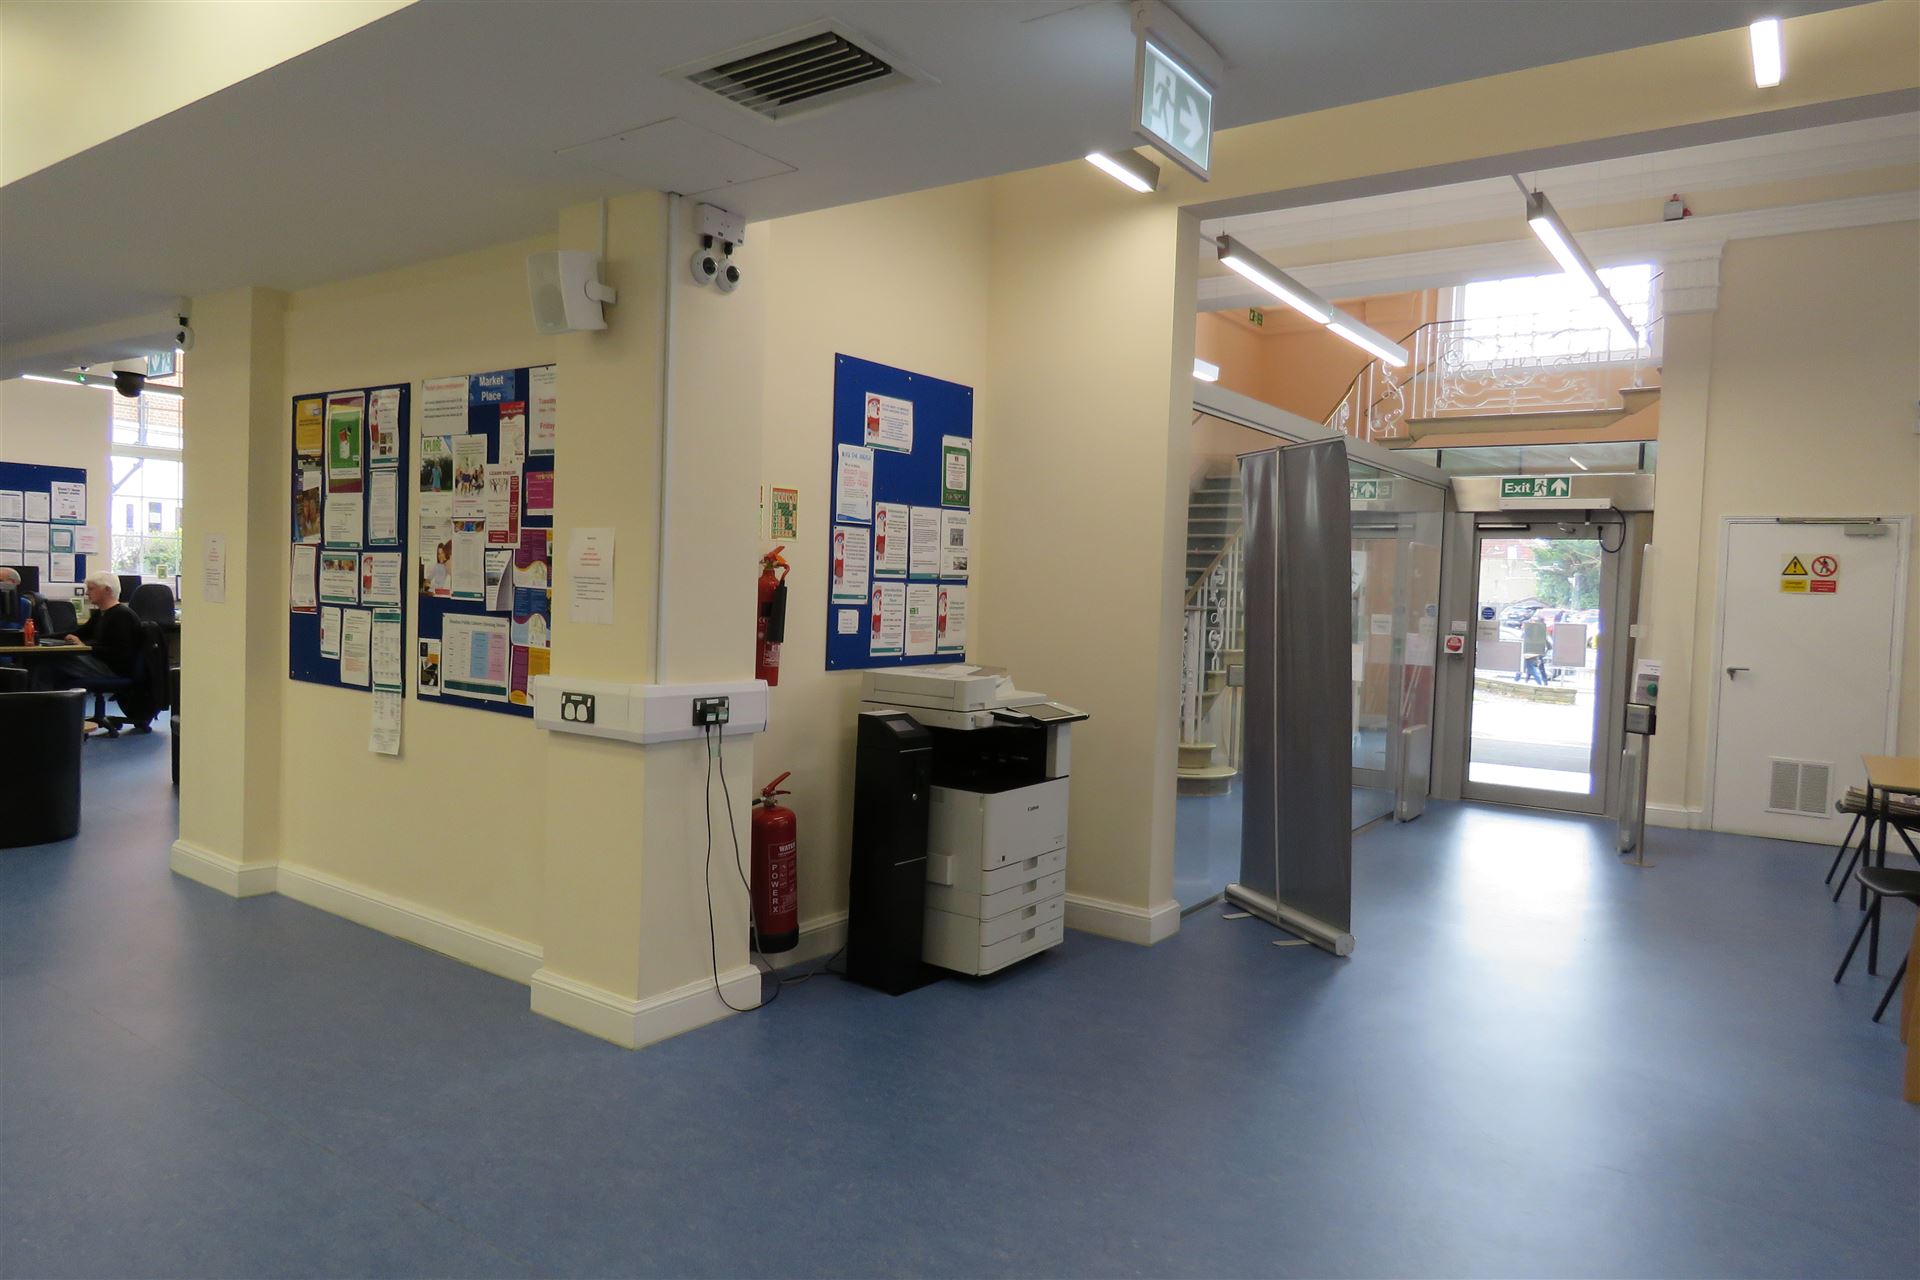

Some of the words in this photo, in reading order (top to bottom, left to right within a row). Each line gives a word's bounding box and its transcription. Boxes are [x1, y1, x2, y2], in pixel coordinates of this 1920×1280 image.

[479, 375, 504, 387] Market
[481, 391, 502, 402] Place
[1504, 482, 1531, 493] Exit
[770, 864, 780, 914] POWERX
